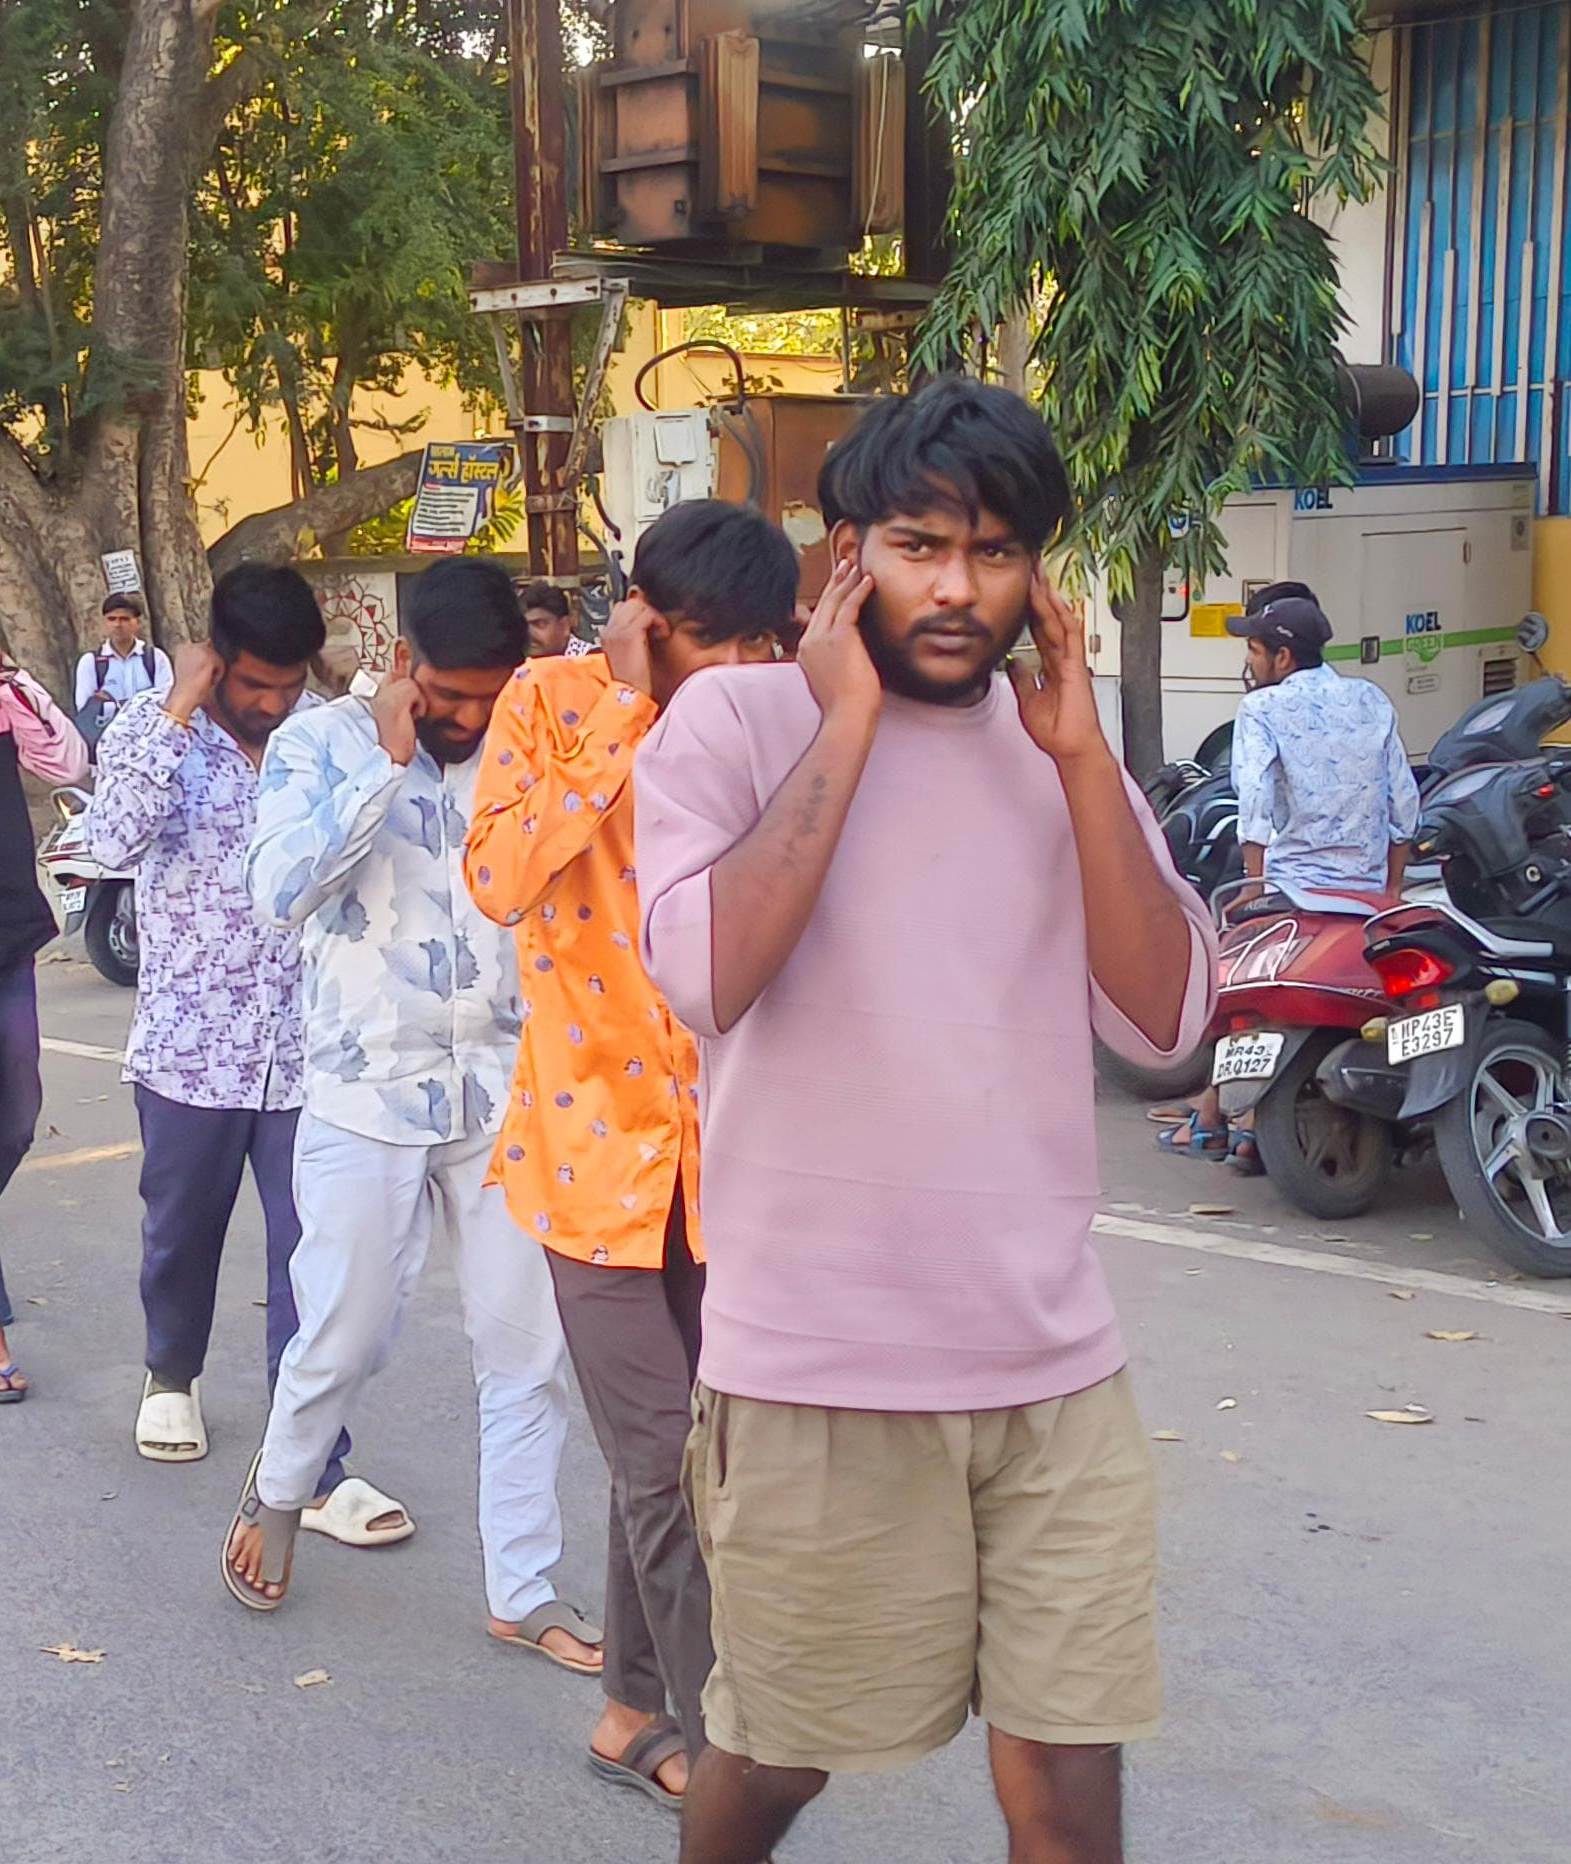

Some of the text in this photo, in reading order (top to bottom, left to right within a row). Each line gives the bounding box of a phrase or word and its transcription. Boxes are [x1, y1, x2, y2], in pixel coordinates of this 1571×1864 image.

[1294, 487, 1333, 510] KOEL
[1406, 611, 1441, 634] KOEL
[1401, 1027, 1454, 1057] E3297
